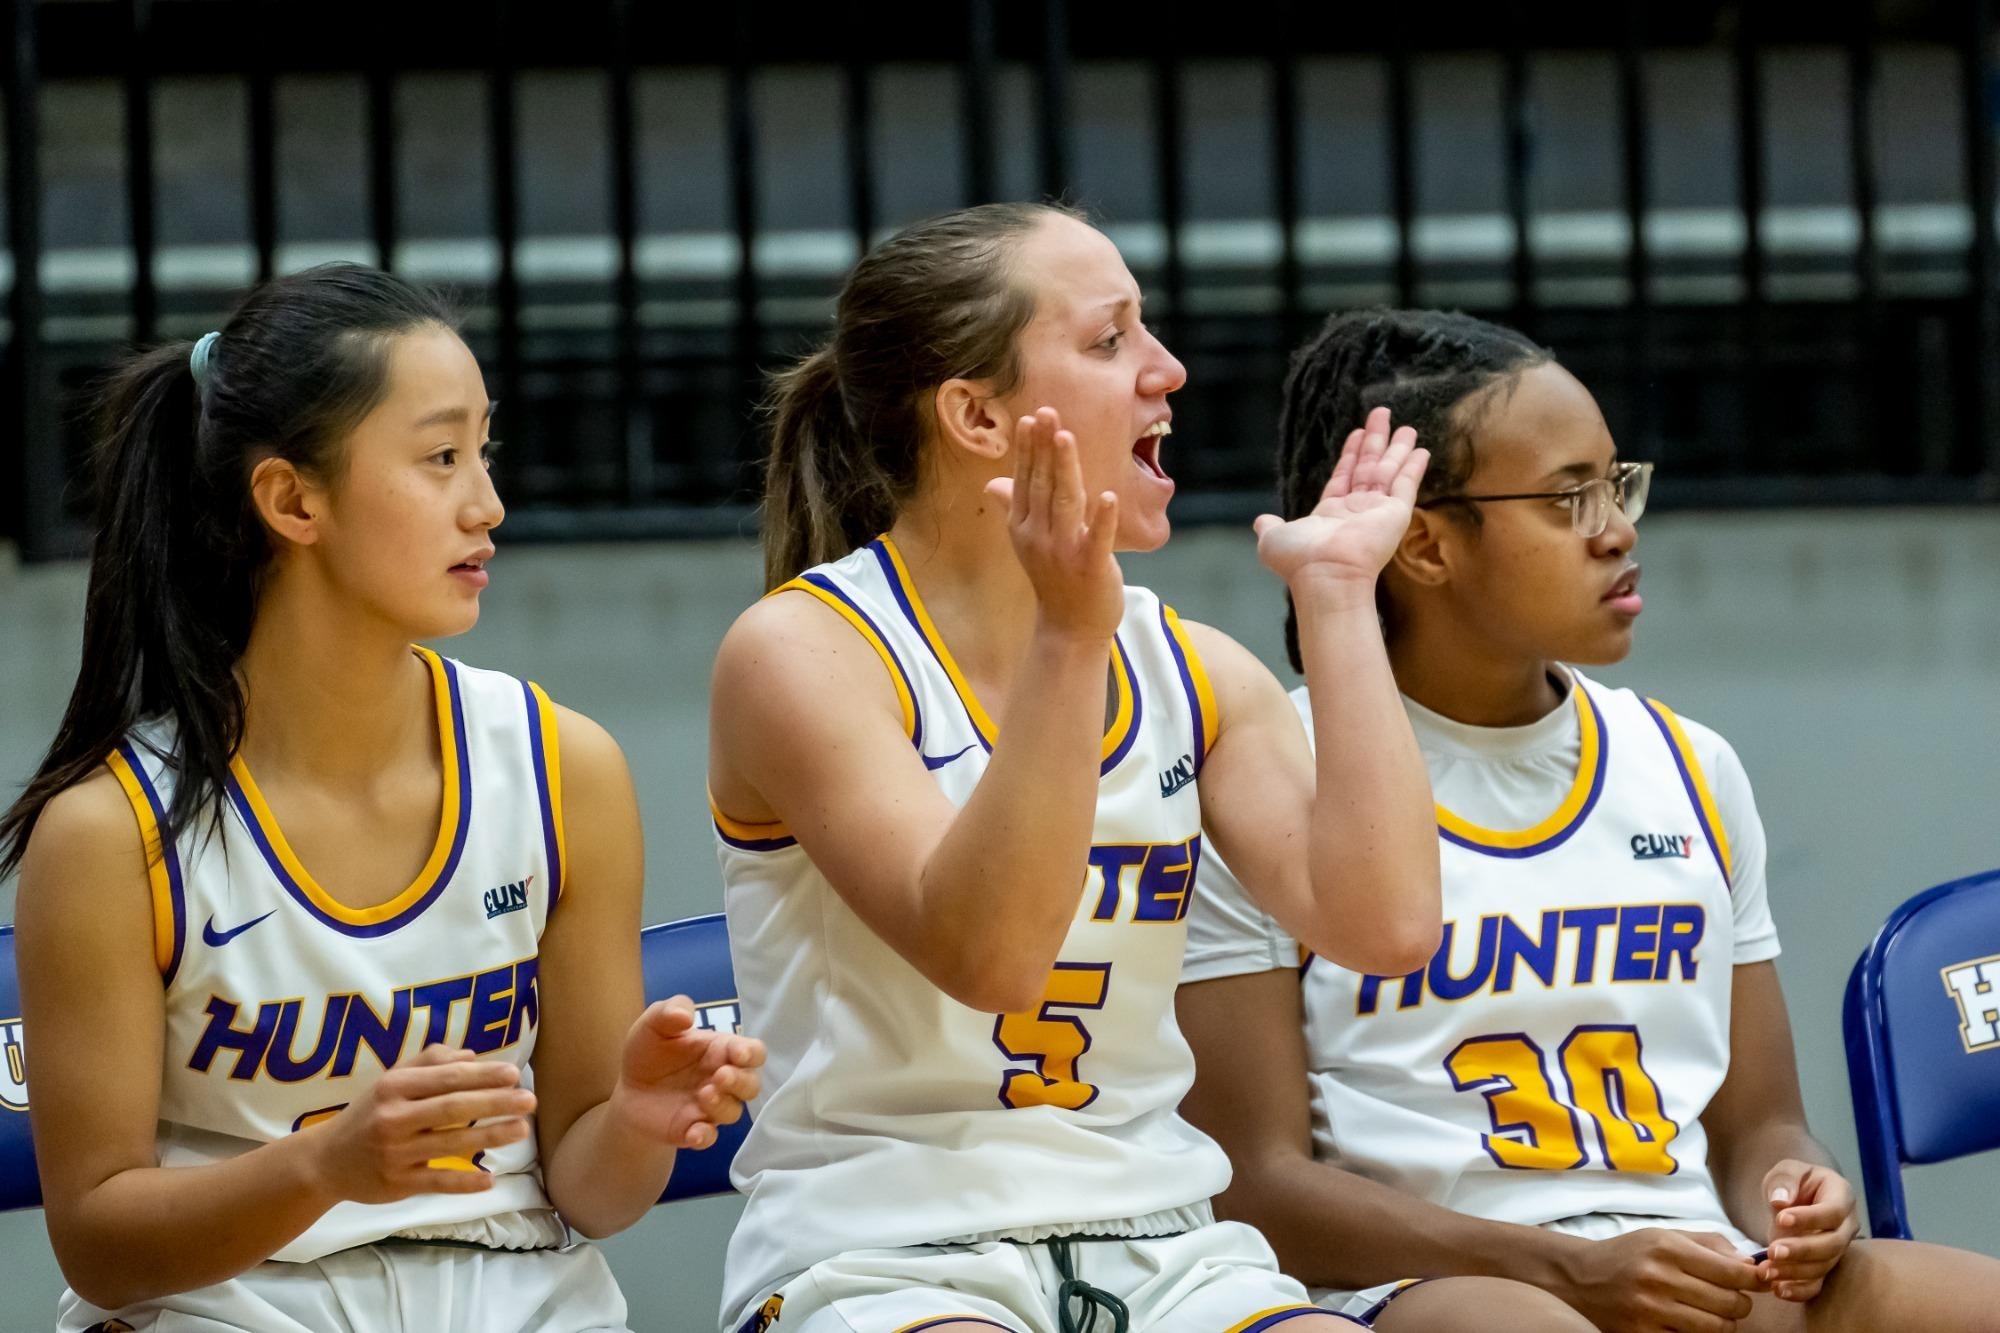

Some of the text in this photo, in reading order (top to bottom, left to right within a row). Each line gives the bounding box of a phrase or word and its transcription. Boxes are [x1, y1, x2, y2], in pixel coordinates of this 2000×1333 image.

[1631, 833, 1692, 858] CUNY
[992, 961, 1112, 1111] 5
[1443, 1024, 1679, 1175] 30
